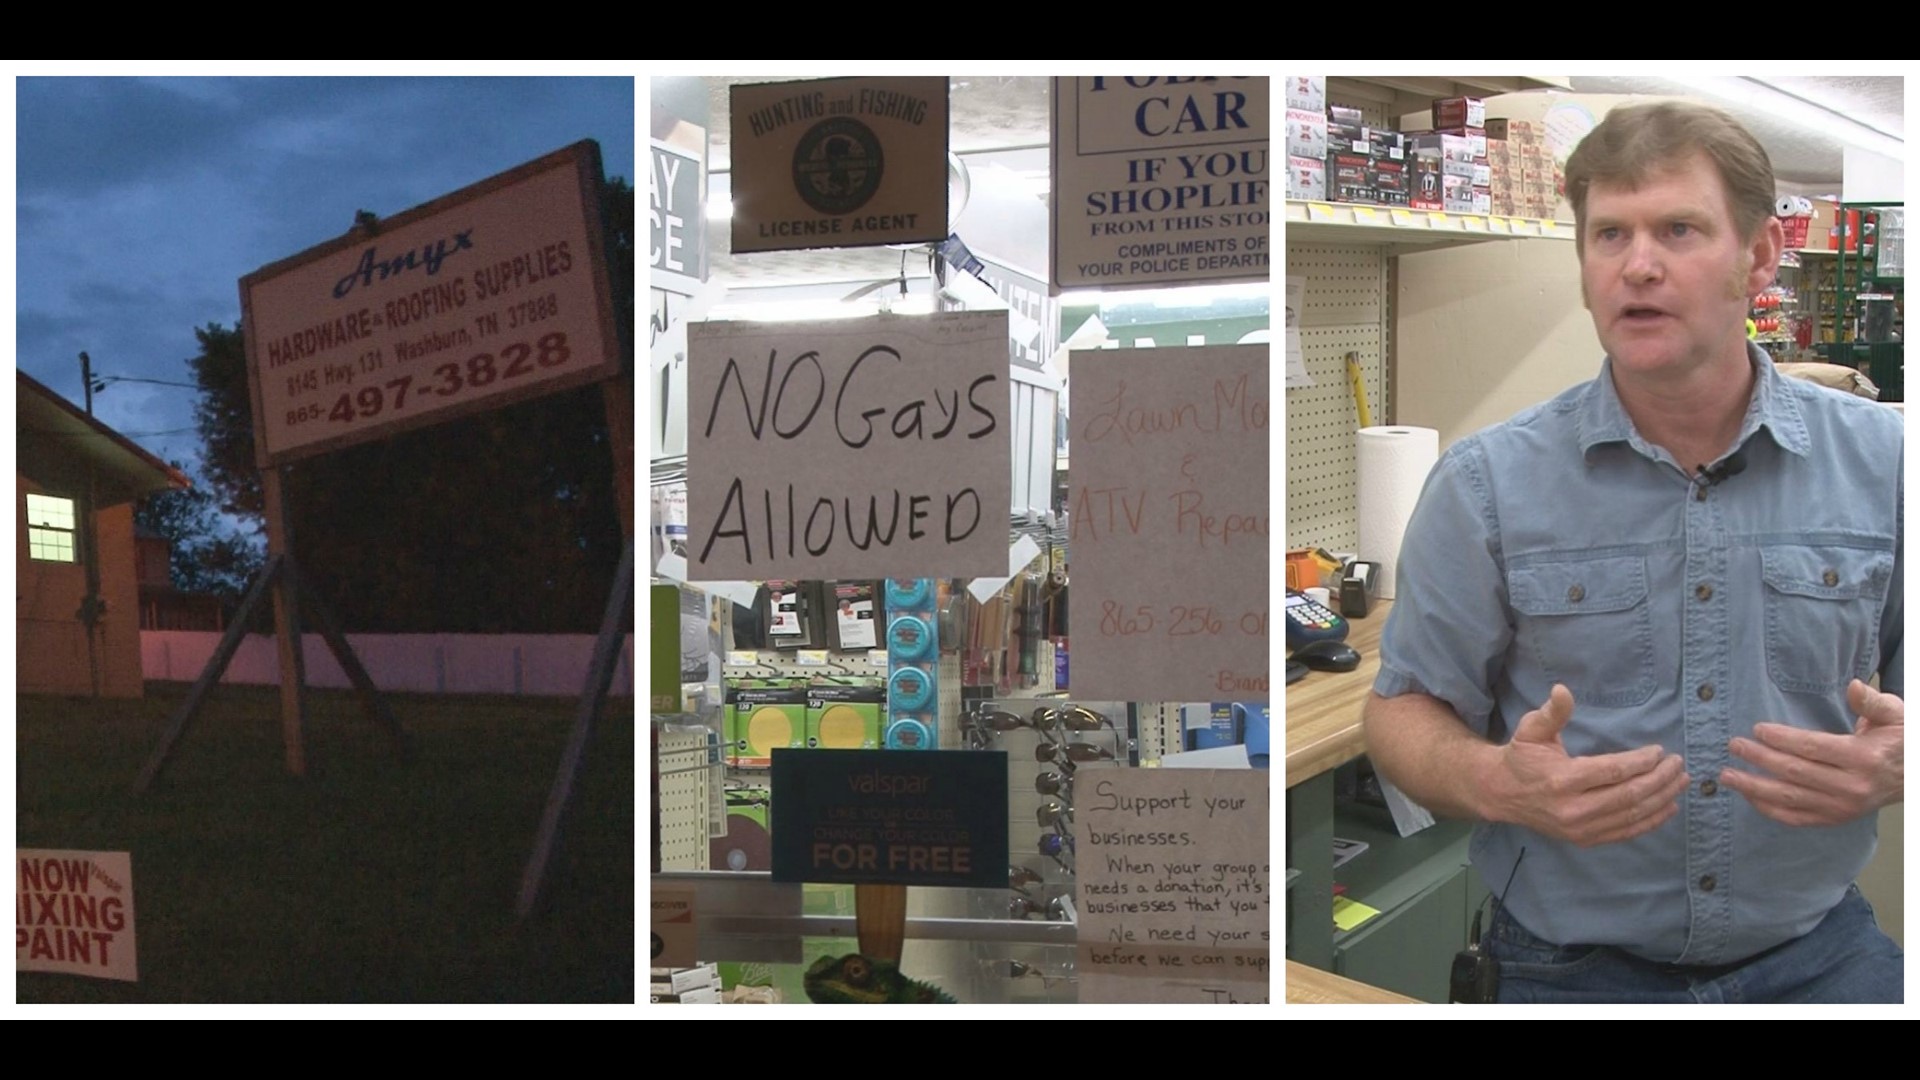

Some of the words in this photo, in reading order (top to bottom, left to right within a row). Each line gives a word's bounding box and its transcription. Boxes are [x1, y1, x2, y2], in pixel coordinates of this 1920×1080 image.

[748, 92, 825, 137] HUNTING
[829, 95, 854, 115] and
[859, 88, 928, 125] FISHING
[1134, 91, 1250, 137] CAR
[1126, 158, 1167, 184] IF
[1177, 149, 1268, 180] YOU
[760, 219, 841, 239] LICENSE
[851, 213, 919, 232] AGENT
[1090, 219, 1155, 237] FROM
[1159, 214, 1214, 232] THIS
[1118, 238, 1237, 259] COMPLIMENTS
[1244, 236, 1267, 252] OF
[332, 227, 474, 300] Amyx
[1079, 262, 1124, 277] YOUR
[1131, 258, 1190, 275] POLICE
[267, 308, 373, 369] HARDWARE
[384, 277, 467, 330] ROOFING
[473, 240, 573, 301] SUPPLIES
[359, 349, 384, 374] 131
[475, 311, 499, 339] TN
[704, 349, 826, 441] NO
[834, 344, 998, 450] Gays
[1084, 378, 1212, 447] Lawn
[1214, 372, 1269, 433] Mo
[1071, 485, 1147, 541] ATV
[848, 768, 931, 798] valspar
[862, 806, 901, 821] YOUR
[905, 807, 956, 822] COLOR
[1089, 780, 1193, 818] Support
[1204, 795, 1246, 818] your
[877, 828, 920, 842] YOUR
[921, 829, 971, 844] COLOR
[1088, 823, 1197, 846] businesses.
[812, 843, 878, 870] FOR
[888, 845, 973, 873] FREE
[1106, 854, 1155, 876] When
[1163, 861, 1202, 883] your
[1212, 863, 1257, 882] group
[20, 857, 90, 893] NOW
[1085, 882, 1129, 895] needs
[1137, 885, 1149, 894] a
[1155, 880, 1232, 898] donation,
[1236, 879, 1263, 894] it's
[16, 893, 126, 932] IXING
[1086, 899, 1177, 914] businesses
[1185, 896, 1221, 912] that
[1229, 899, 1258, 917] you
[1148, 925, 1197, 942] need
[1208, 929, 1251, 947] your
[1090, 947, 1147, 965] before
[1191, 953, 1225, 964] can
[1235, 956, 1269, 972] sup
